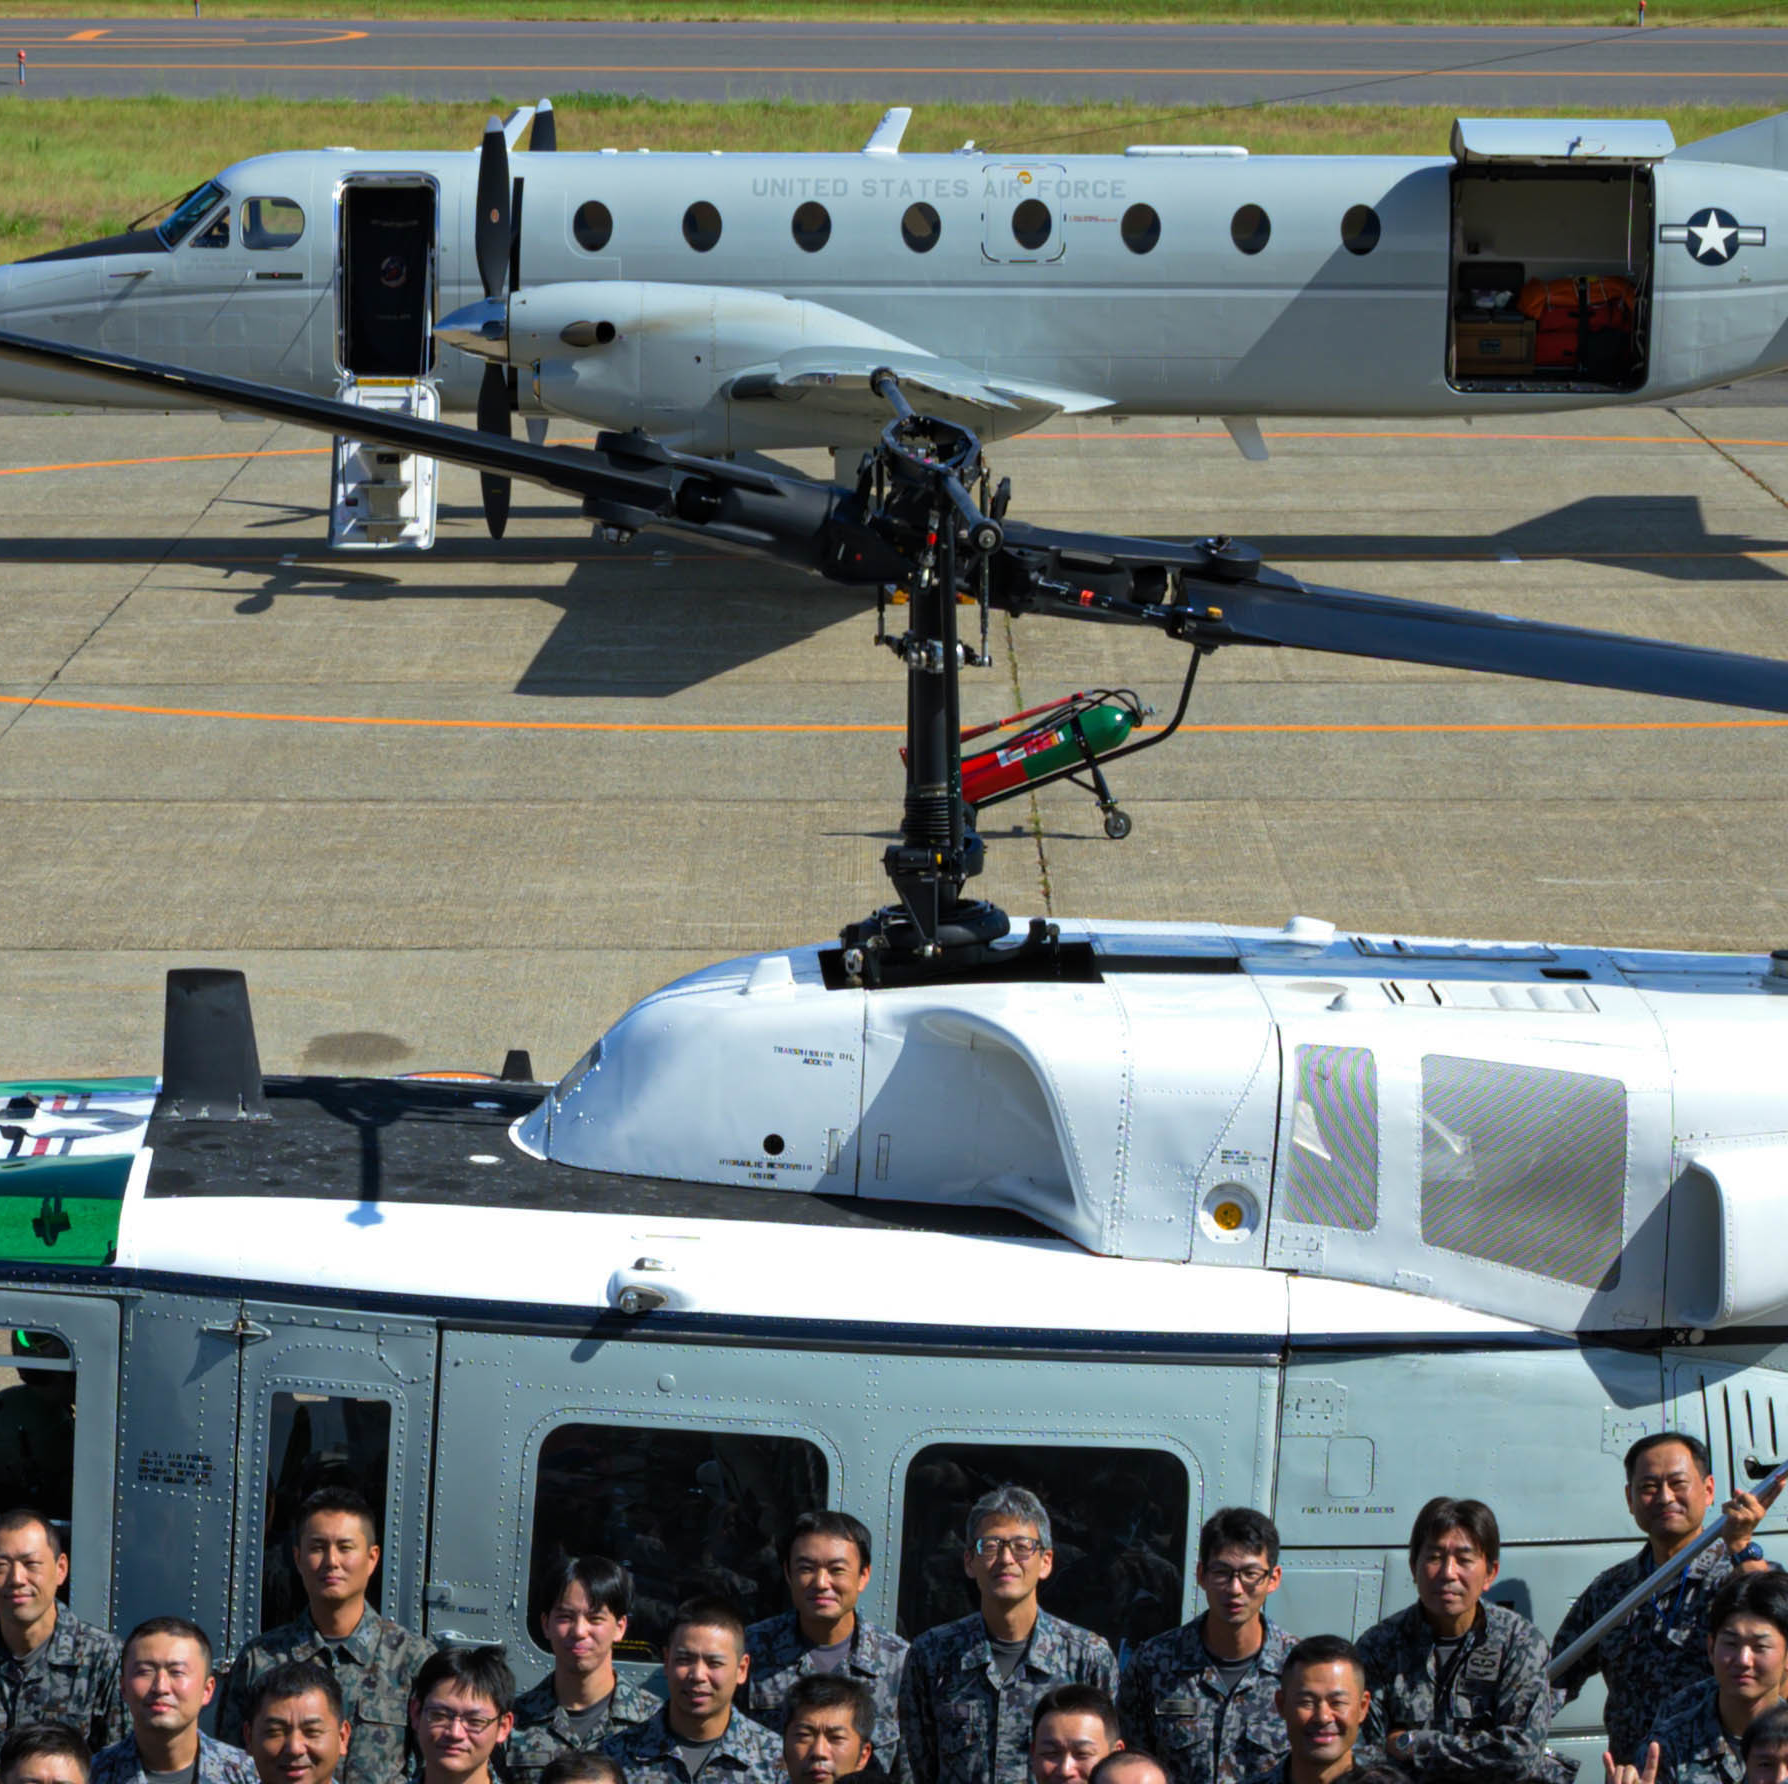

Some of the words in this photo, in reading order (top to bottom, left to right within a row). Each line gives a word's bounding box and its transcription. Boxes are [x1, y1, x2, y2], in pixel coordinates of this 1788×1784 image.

[751, 178, 848, 198] UNITED
[861, 178, 969, 199] STATES
[983, 179, 1024, 199] AIR
[1037, 179, 1127, 200] FORCE
